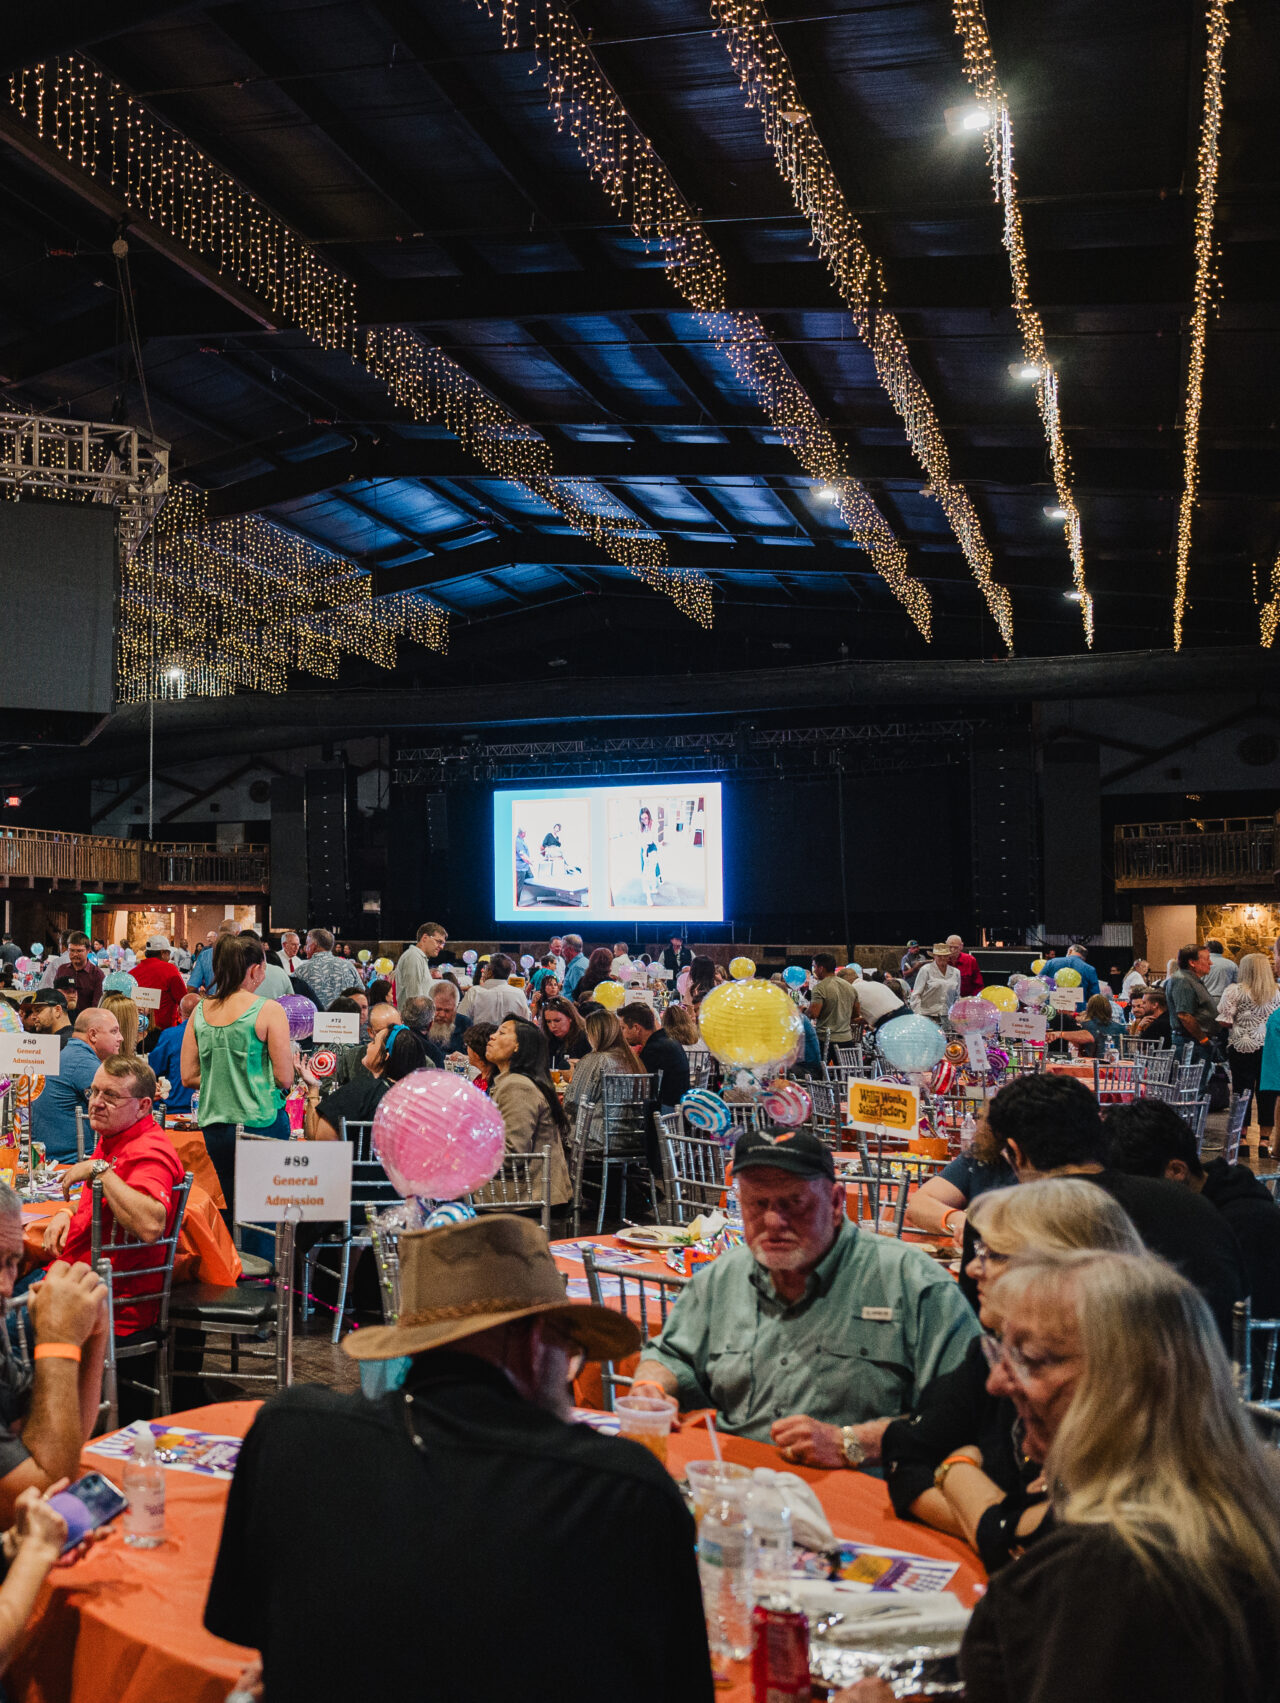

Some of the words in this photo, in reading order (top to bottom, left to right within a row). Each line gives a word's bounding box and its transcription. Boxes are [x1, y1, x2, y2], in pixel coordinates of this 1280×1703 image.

[16, 1047, 42, 1055] General
[12, 1057, 45, 1065] Admission
[881, 1091, 908, 1107] Wonka
[879, 1104, 907, 1123] Factory
[283, 1155, 310, 1168] #89
[272, 1174, 318, 1187] General
[265, 1194, 325, 1206] Admission
